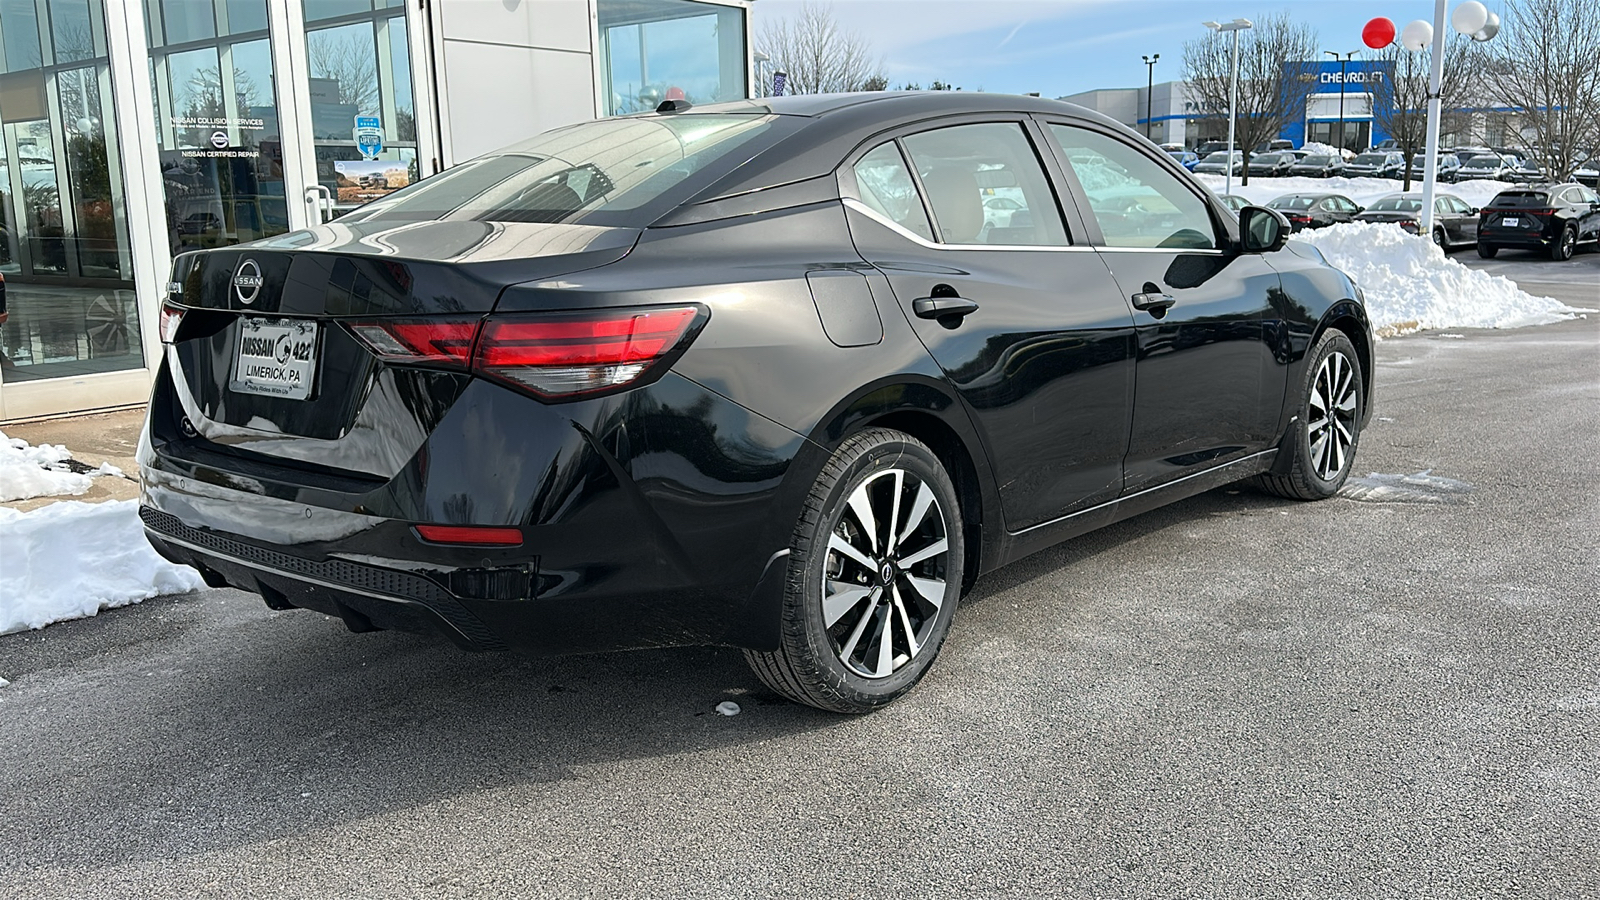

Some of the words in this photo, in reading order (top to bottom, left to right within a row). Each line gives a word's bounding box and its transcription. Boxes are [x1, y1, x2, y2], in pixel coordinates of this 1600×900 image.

[1320, 71, 1383, 84] CHEVROLET
[197, 117, 232, 125] COLLISION
[233, 118, 264, 126] SERVICES
[181, 150, 206, 158] NISSAN
[234, 277, 262, 286] NSSAN
[241, 336, 275, 358] NISSAN
[246, 364, 287, 382] LIMERICK,
[289, 369, 301, 382] PA
[247, 384, 259, 392] Philly
